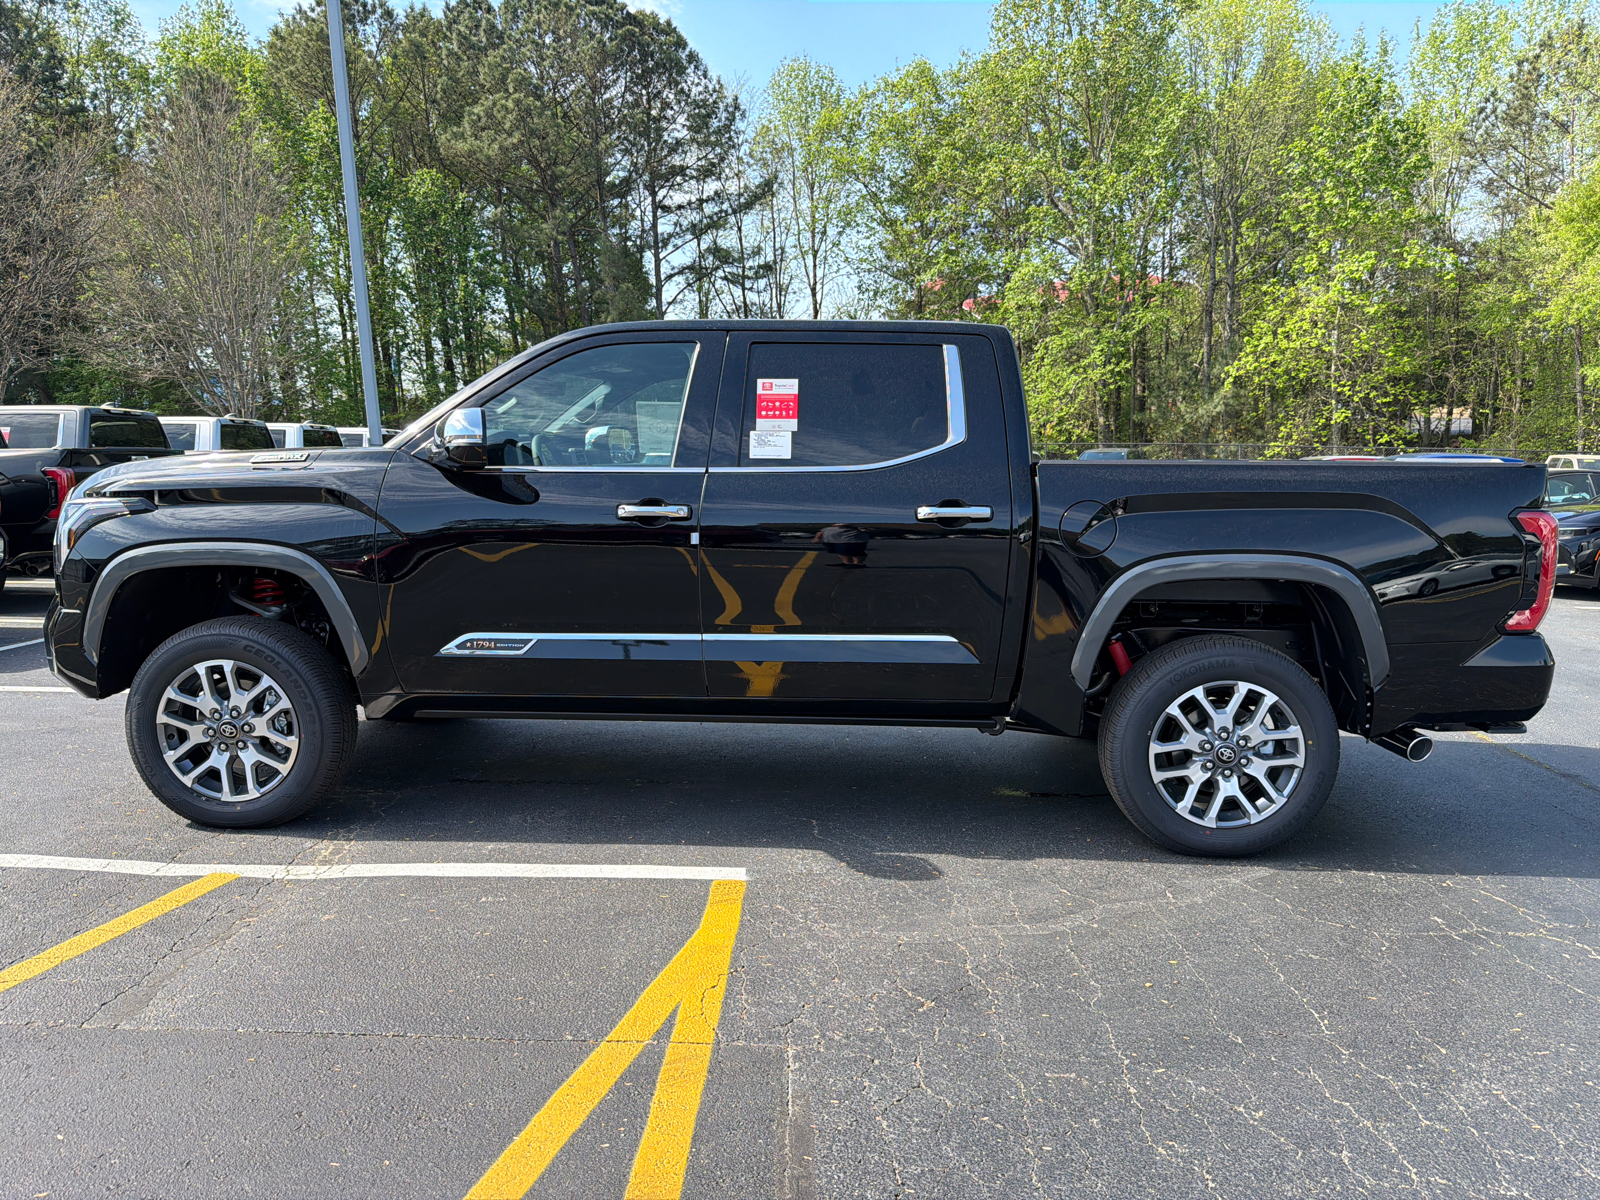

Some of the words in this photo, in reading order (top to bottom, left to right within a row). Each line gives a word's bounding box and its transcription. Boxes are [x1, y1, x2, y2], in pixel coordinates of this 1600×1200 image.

[473, 641, 495, 649] 1794
[243, 644, 316, 724] GEOLANDAR
[1166, 658, 1236, 686] YOKOHAMA
[133, 717, 157, 780] YOKOHAMA
